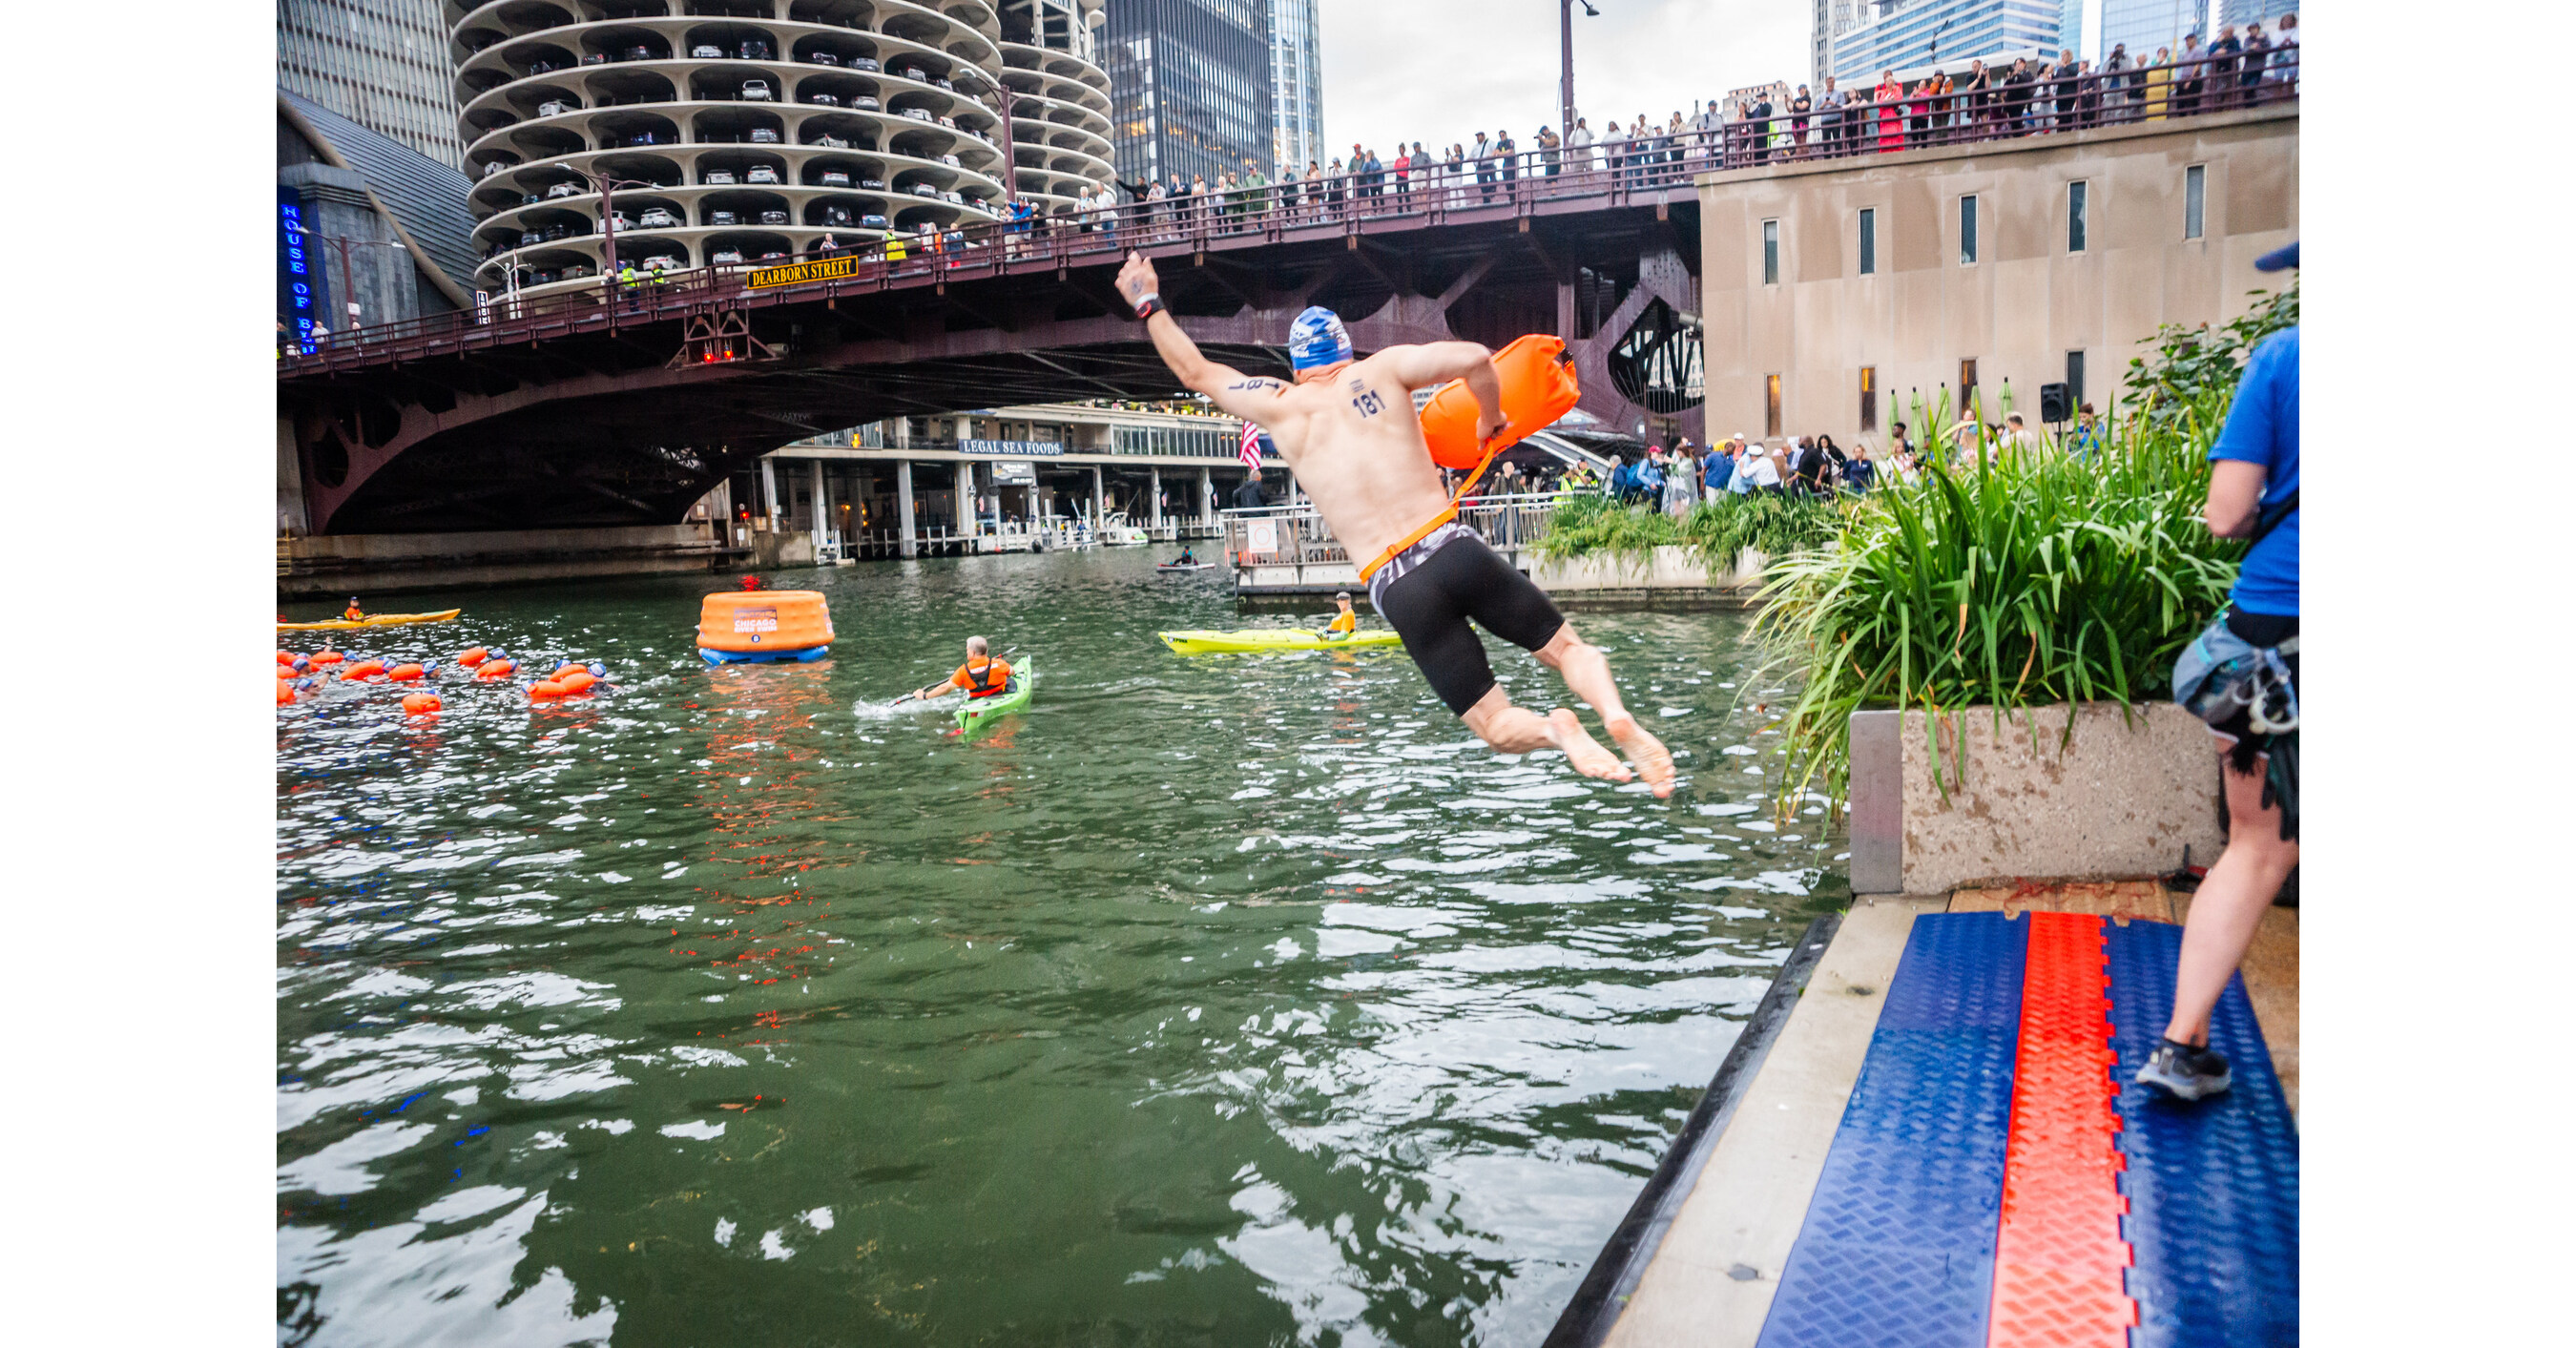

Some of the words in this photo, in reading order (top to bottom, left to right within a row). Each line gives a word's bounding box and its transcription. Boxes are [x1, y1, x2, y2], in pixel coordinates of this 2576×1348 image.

[281, 204, 307, 275] HOUSE
[753, 265, 809, 286] DEARBORN
[811, 259, 852, 278] STREET
[292, 281, 311, 309] OF
[1228, 379, 1280, 390] 181
[1353, 389, 1386, 418] 181
[964, 440, 1000, 453] LEGAL
[1003, 441, 1024, 454] SEA
[1026, 442, 1061, 455] FOODS
